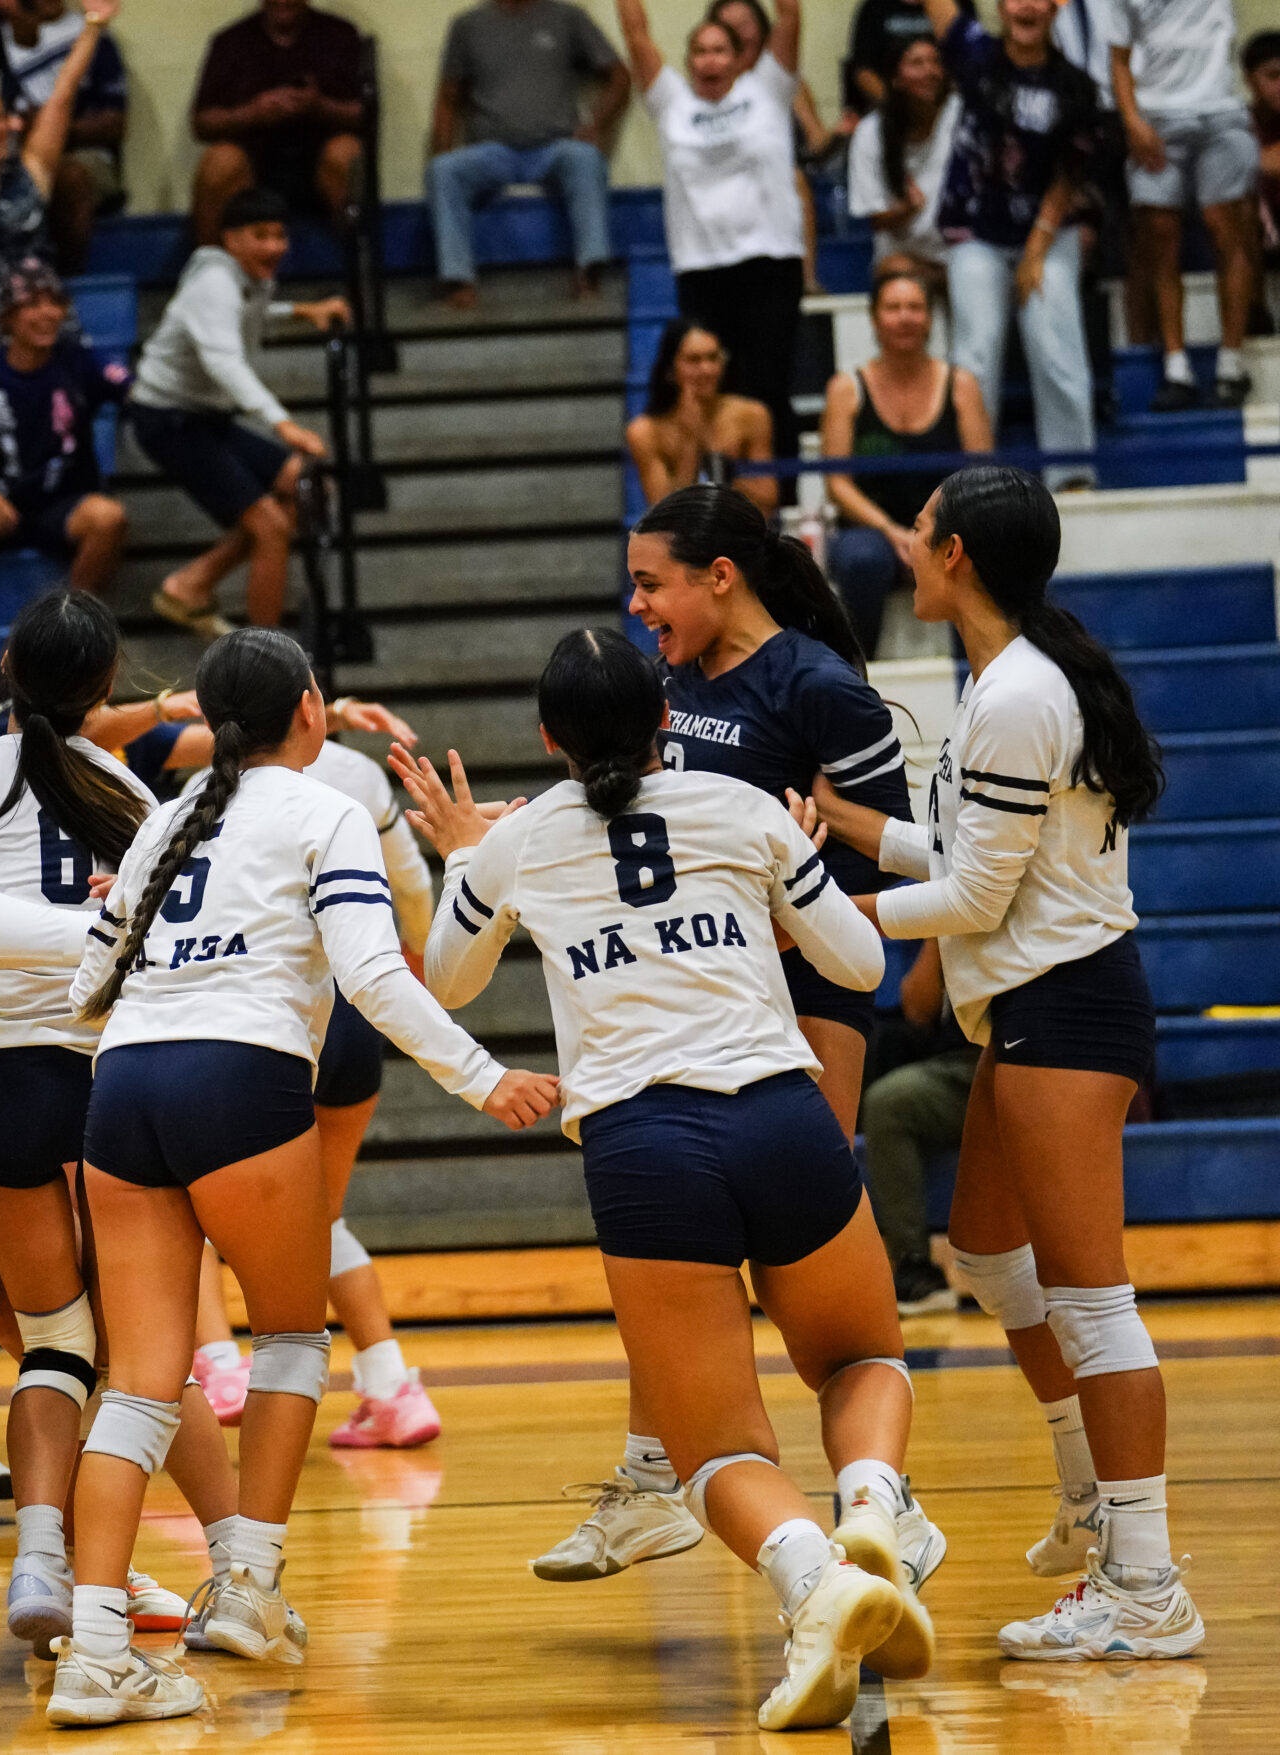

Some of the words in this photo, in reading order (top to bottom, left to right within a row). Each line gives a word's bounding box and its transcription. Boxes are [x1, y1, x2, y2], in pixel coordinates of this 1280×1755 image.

[159, 818, 226, 924] 5
[606, 812, 677, 909] 8
[566, 922, 638, 981] NĀ
[654, 912, 747, 955] KOA
